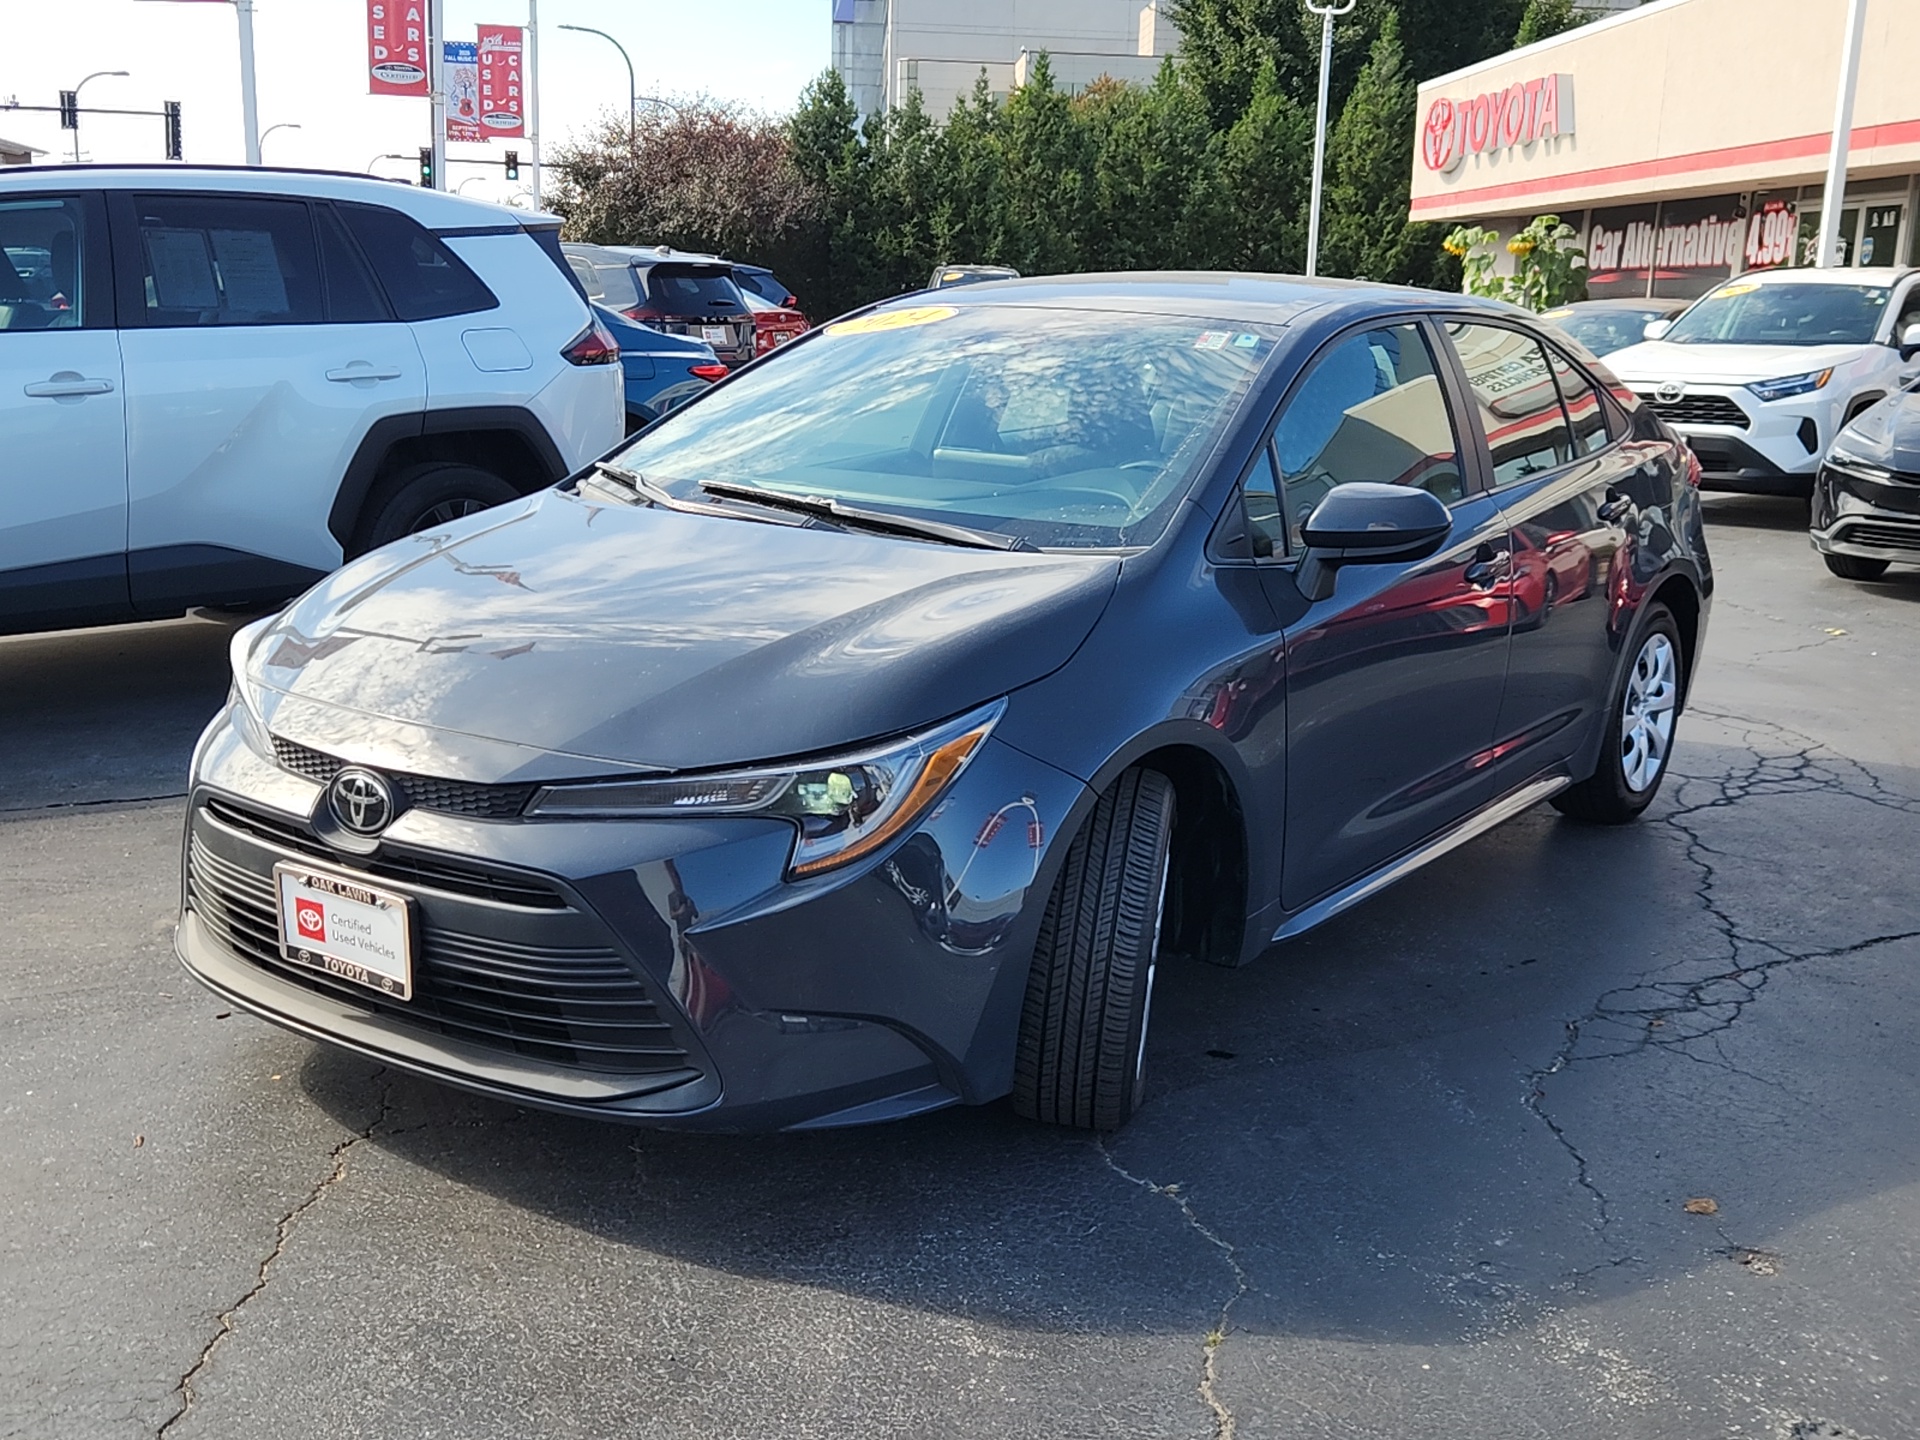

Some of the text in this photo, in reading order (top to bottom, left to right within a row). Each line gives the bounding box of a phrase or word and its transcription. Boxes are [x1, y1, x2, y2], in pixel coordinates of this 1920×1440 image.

[372, 0, 388, 60] SED
[406, 0, 421, 62] ARS
[1458, 73, 1558, 156] TOYOTA
[1588, 225, 1621, 269] Car
[1621, 215, 1740, 268] Alternative
[311, 877, 372, 904] OAK LAWN
[331, 913, 372, 935] Certified
[331, 930, 396, 960] Used Vehicles
[323, 956, 369, 983] TOYOTA
